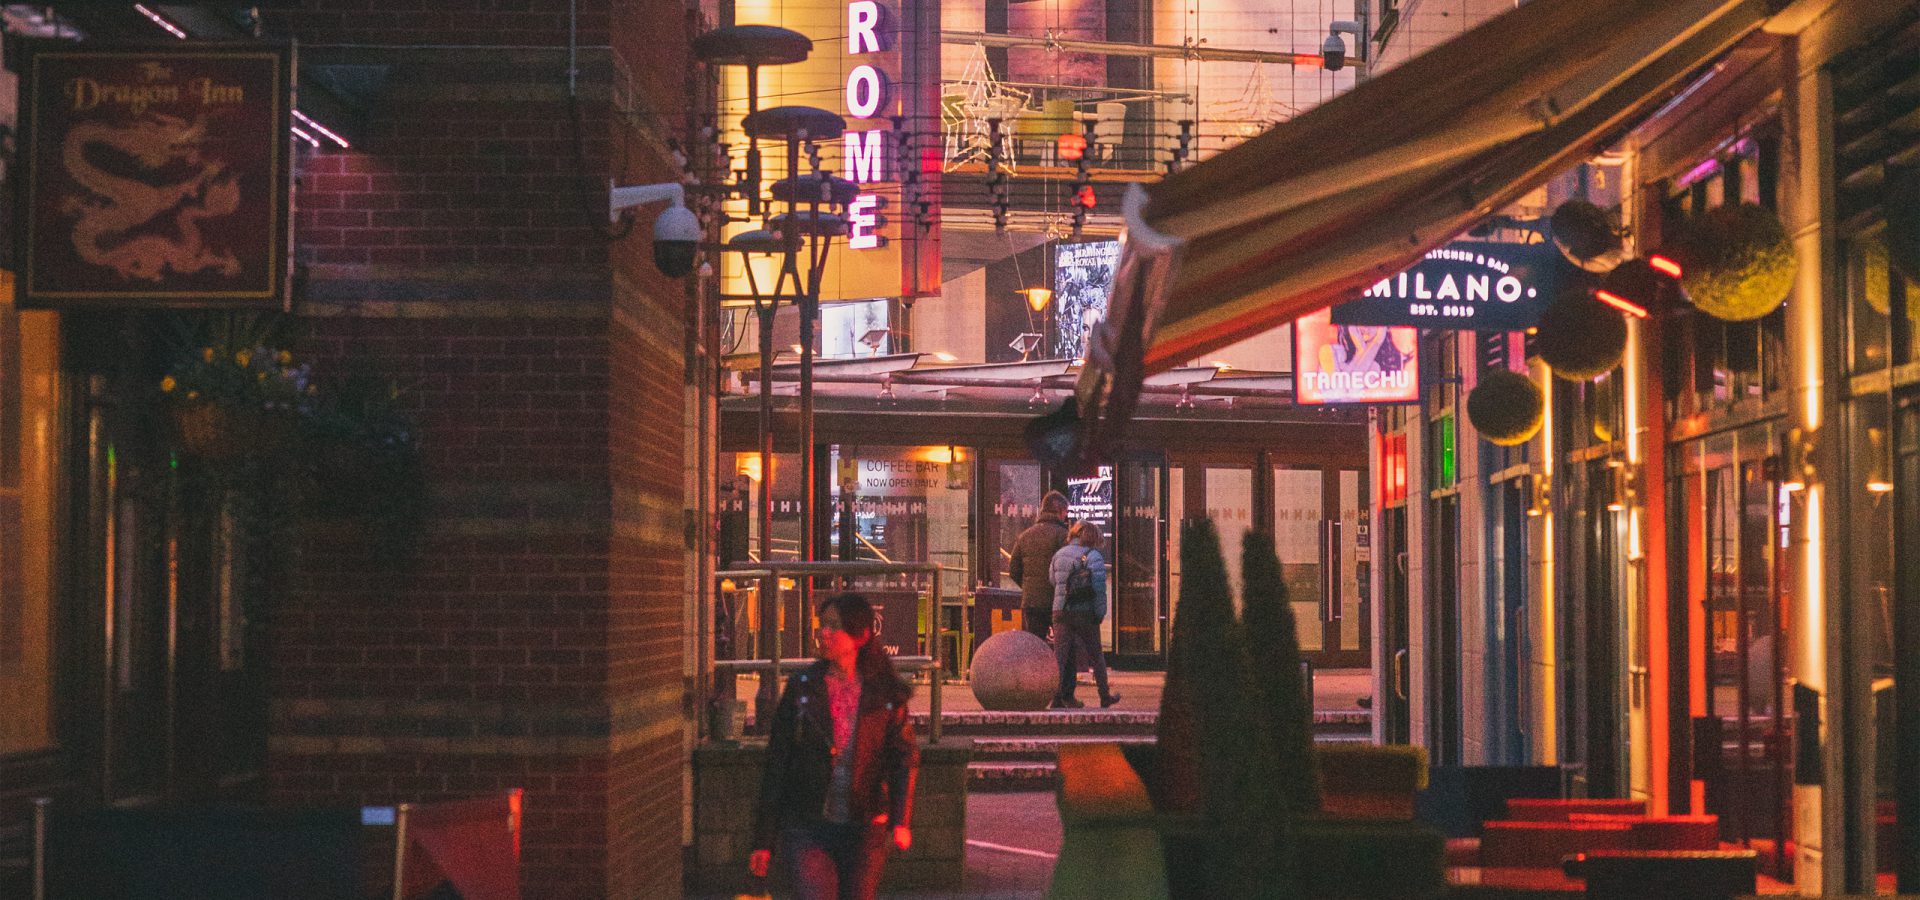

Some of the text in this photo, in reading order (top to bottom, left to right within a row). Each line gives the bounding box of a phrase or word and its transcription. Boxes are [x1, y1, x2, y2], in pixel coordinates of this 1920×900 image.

[63, 76, 245, 117] Dragon Inn
[1443, 305, 1475, 317] 2019
[1302, 370, 1409, 390] TAMECHU
[866, 460, 939, 473] COFFEE BAR
[866, 478, 887, 488] NOW
[889, 478, 912, 488] OPEN
